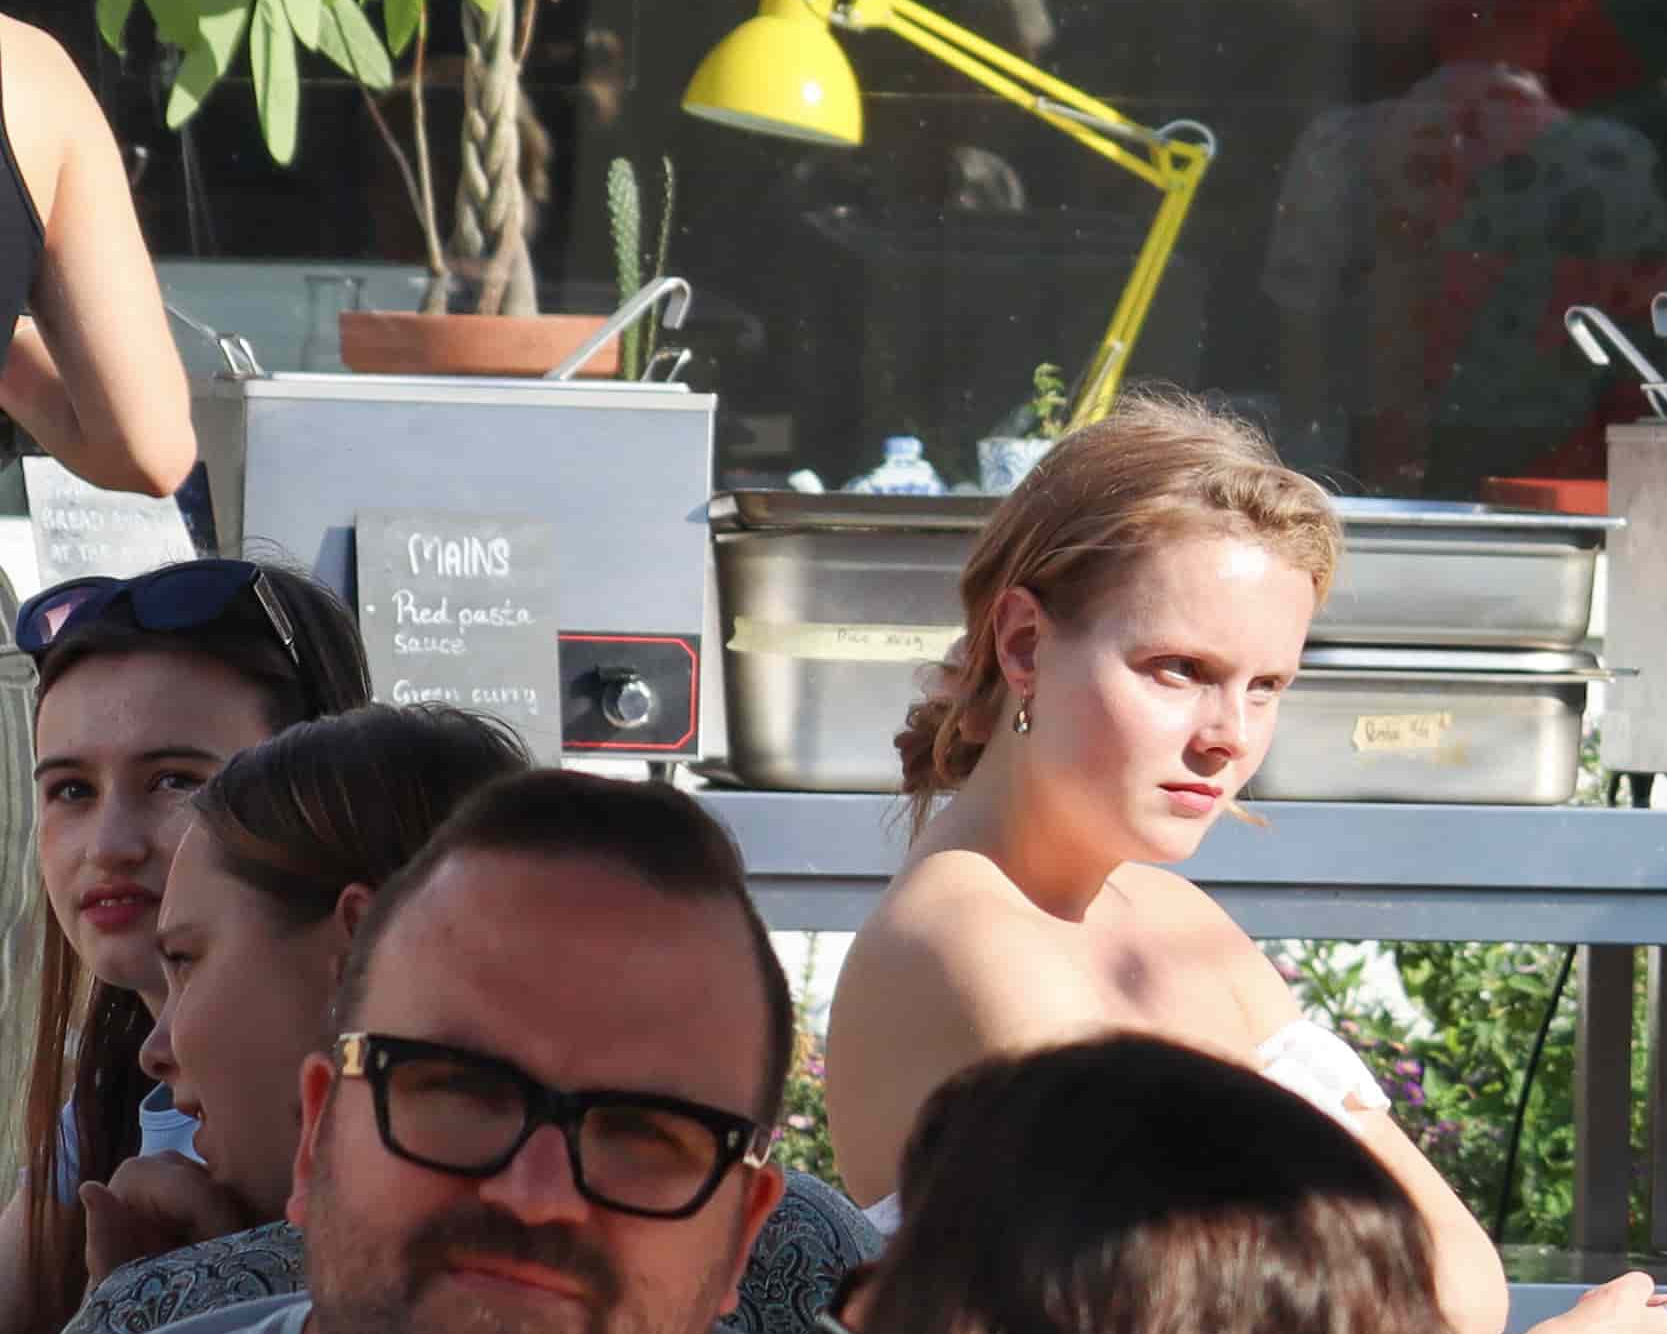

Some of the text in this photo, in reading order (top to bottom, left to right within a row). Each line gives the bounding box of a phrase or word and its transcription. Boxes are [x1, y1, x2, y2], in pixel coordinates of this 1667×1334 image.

[407, 532, 512, 577] MAINS
[391, 589, 536, 635] Red pasta
